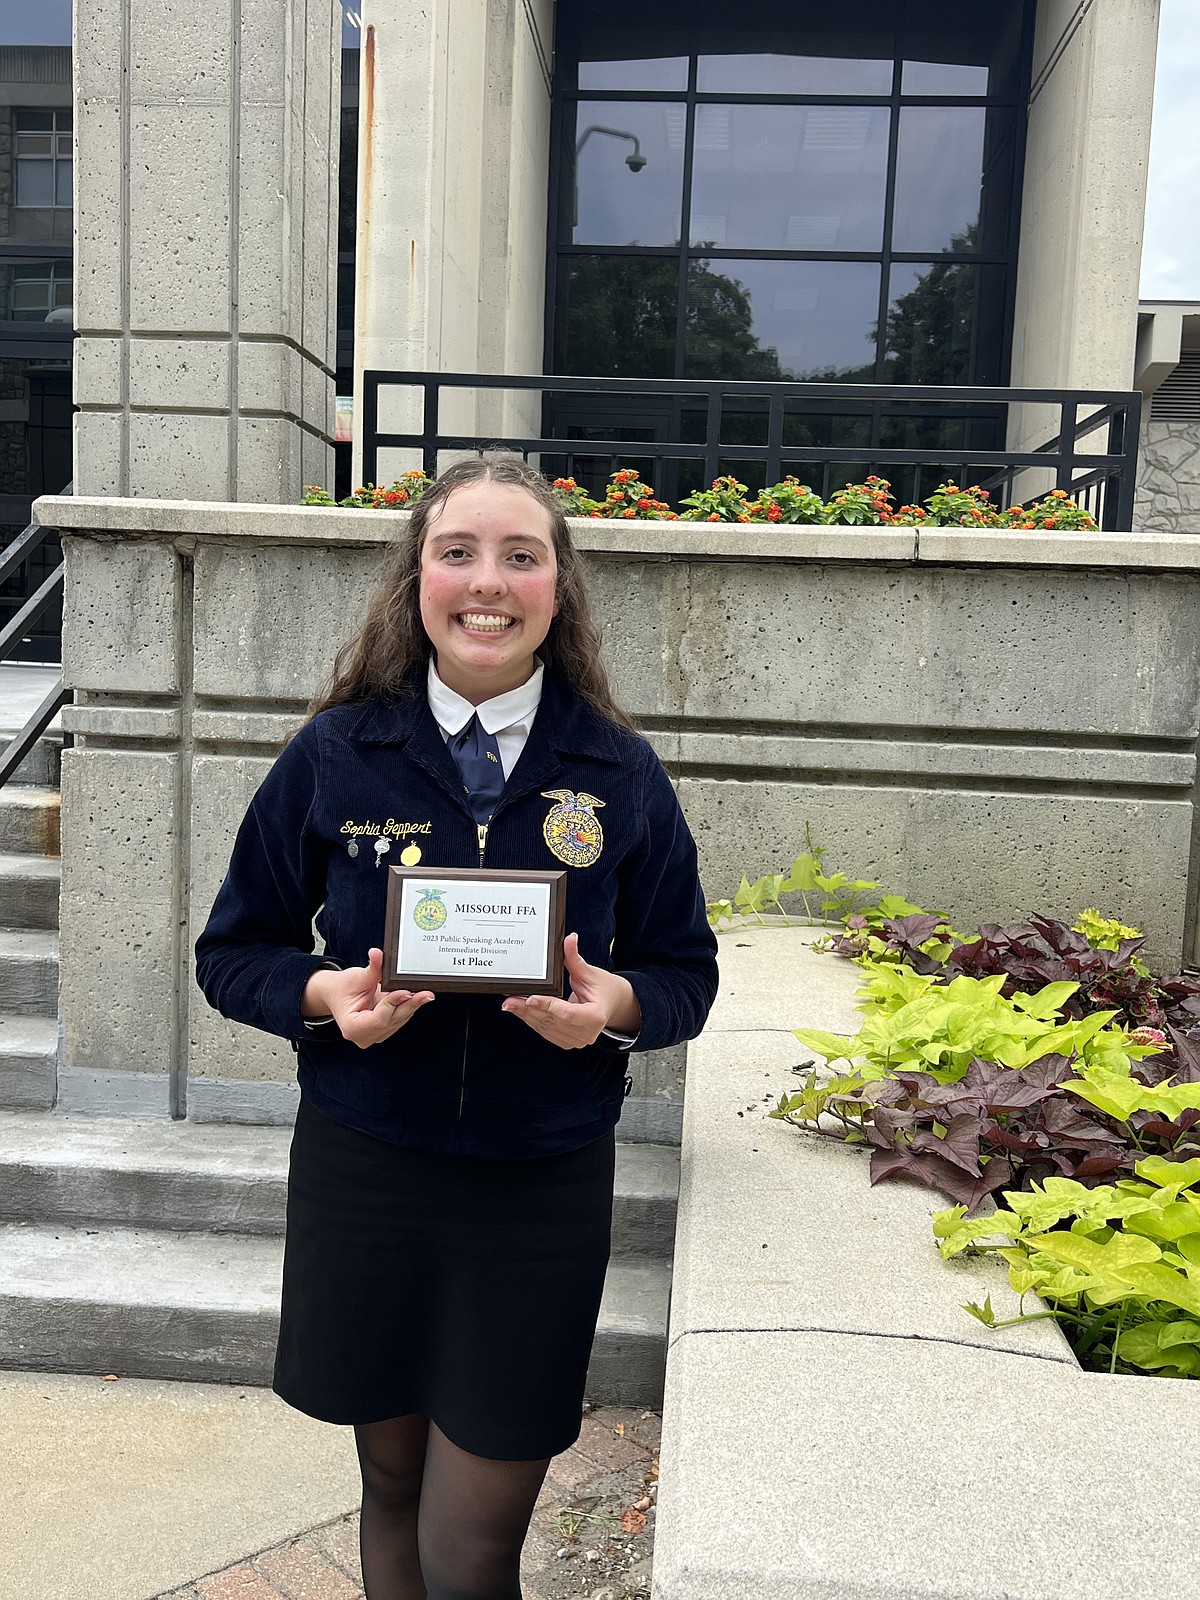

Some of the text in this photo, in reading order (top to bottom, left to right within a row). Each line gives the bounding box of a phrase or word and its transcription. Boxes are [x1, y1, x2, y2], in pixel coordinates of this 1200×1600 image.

[340, 818, 433, 840] Sophia Geppert
[455, 903, 537, 916] MISSOURI FFA
[440, 935, 462, 943] Public
[462, 936, 493, 945] Speaking
[493, 937, 525, 946] Academy
[438, 946, 508, 955] Intermediate Division
[452, 957, 494, 967] 1st Place
